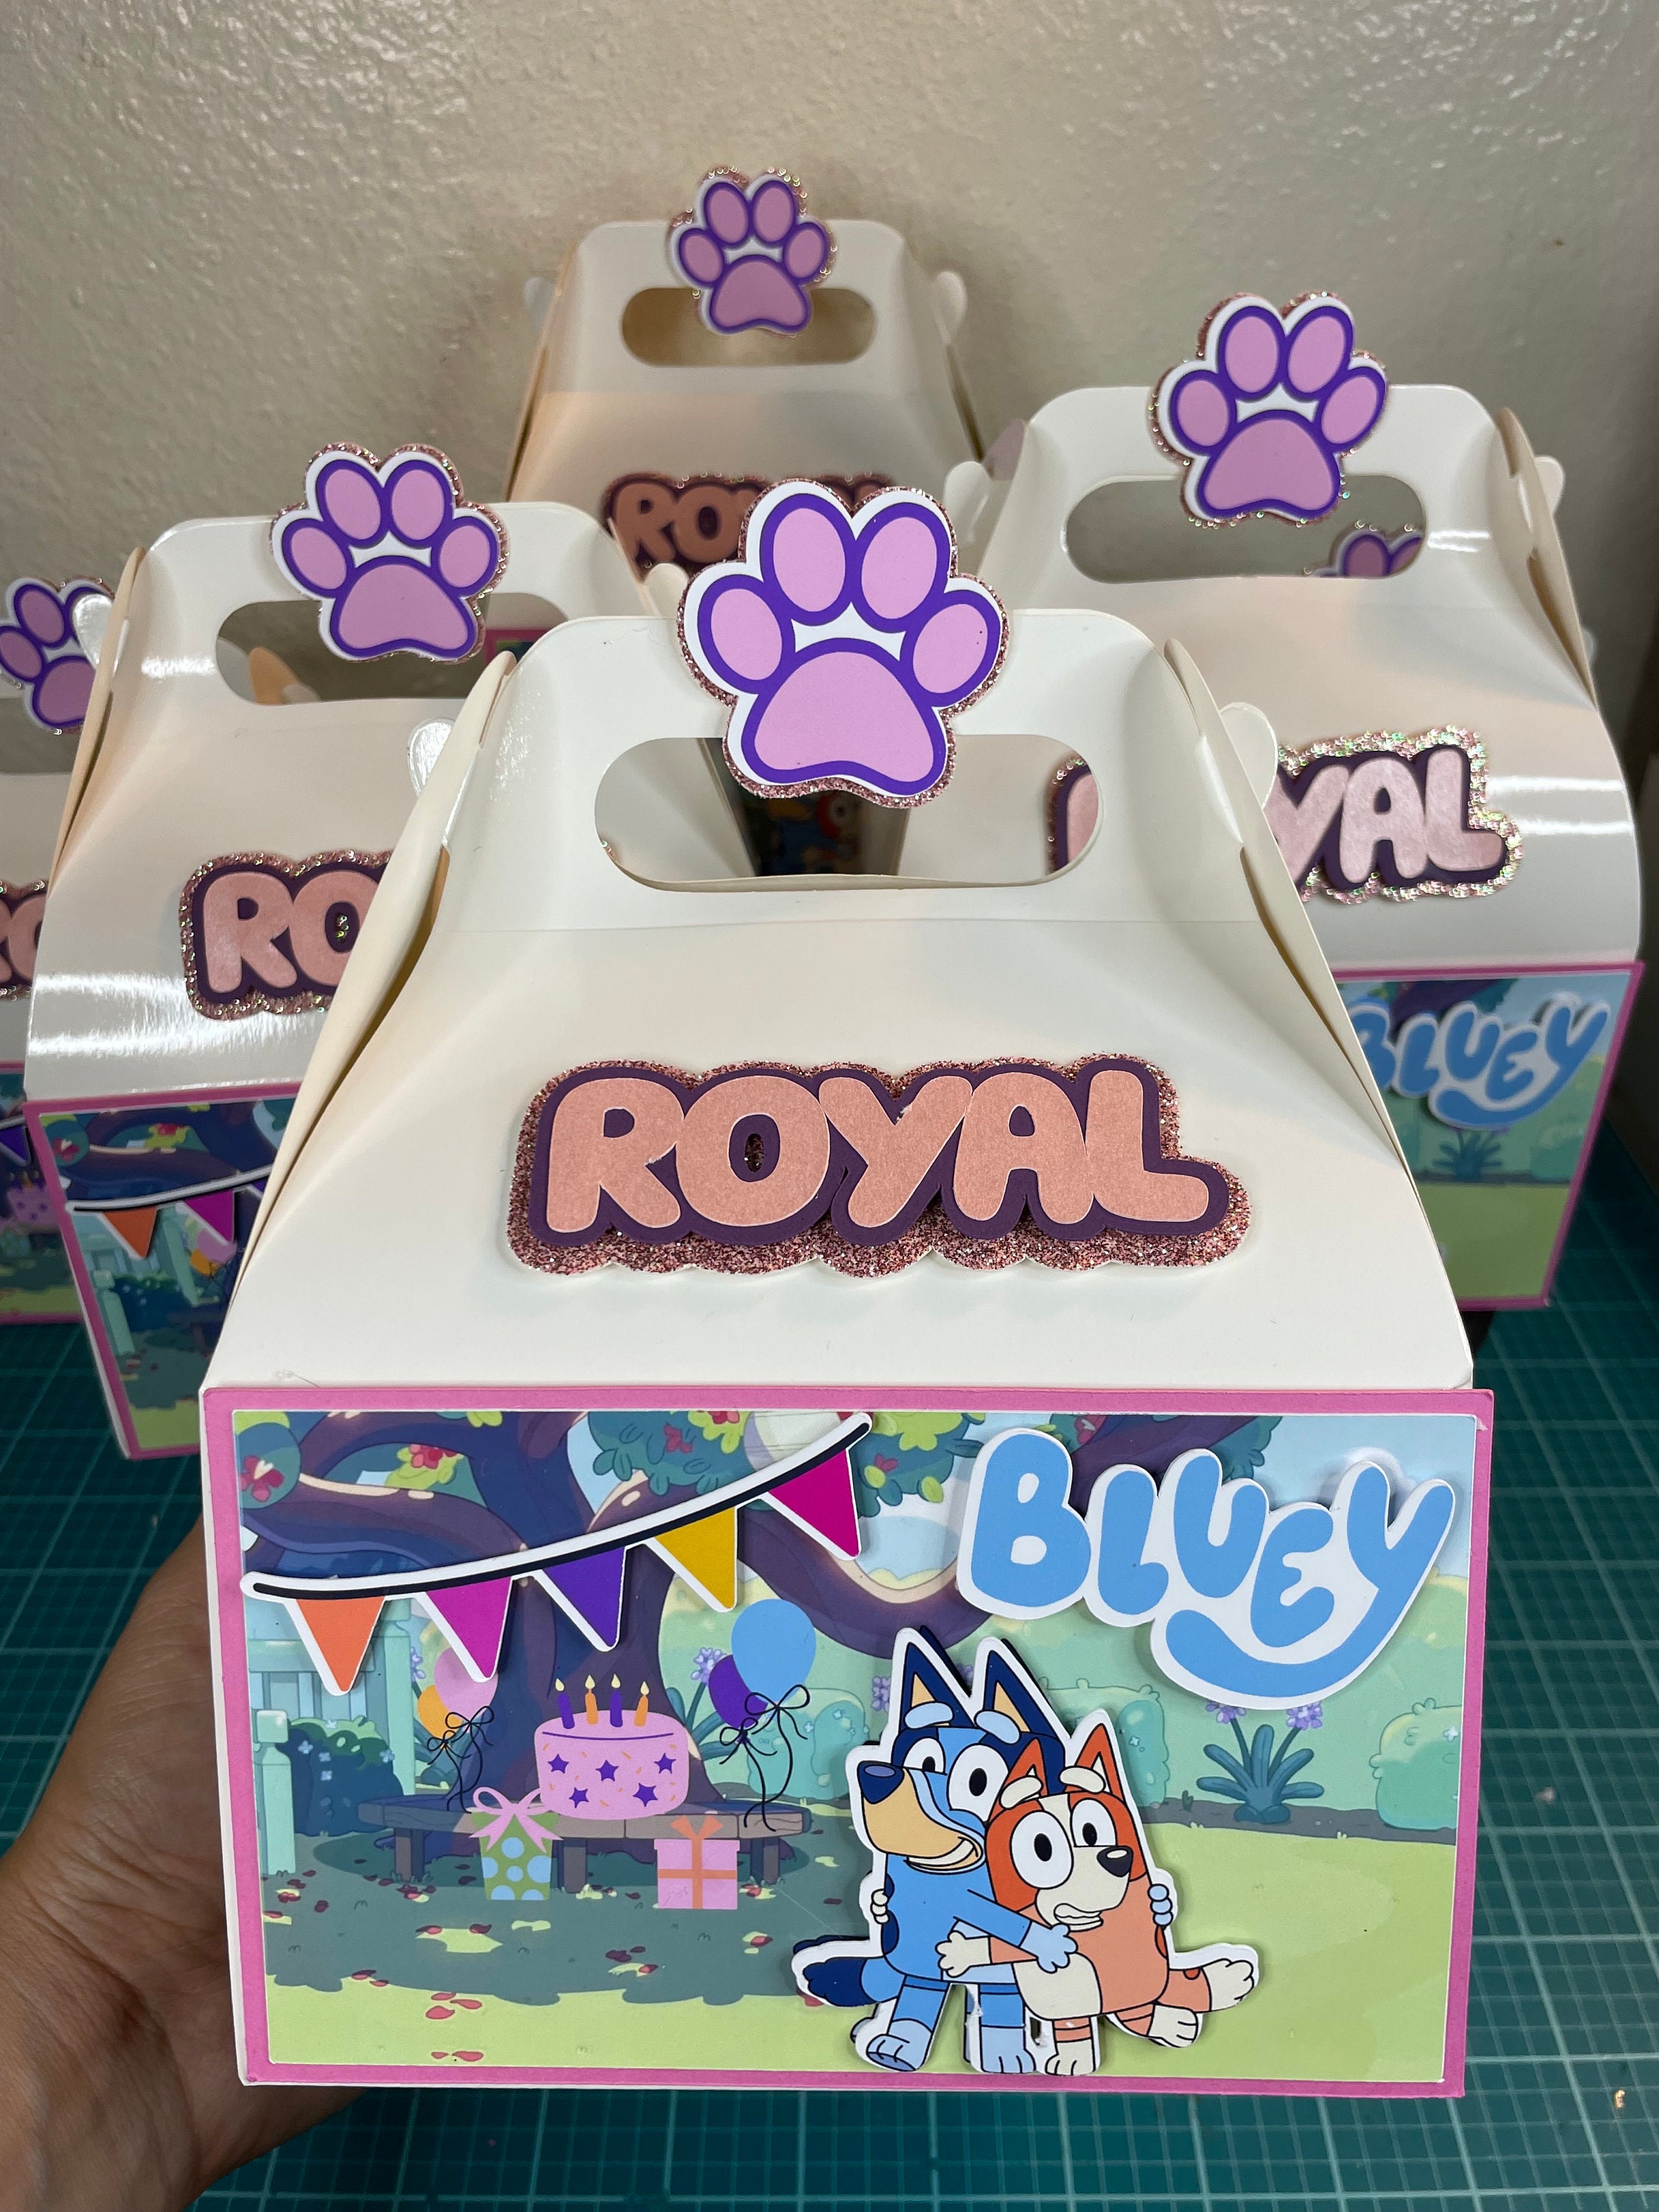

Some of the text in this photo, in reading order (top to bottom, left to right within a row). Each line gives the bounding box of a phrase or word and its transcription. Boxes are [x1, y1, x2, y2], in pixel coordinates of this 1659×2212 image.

[1263, 748, 1503, 884] YAL
[546, 1068, 1209, 1232] ROYAL
[970, 1433, 1455, 1699] BLUEY
